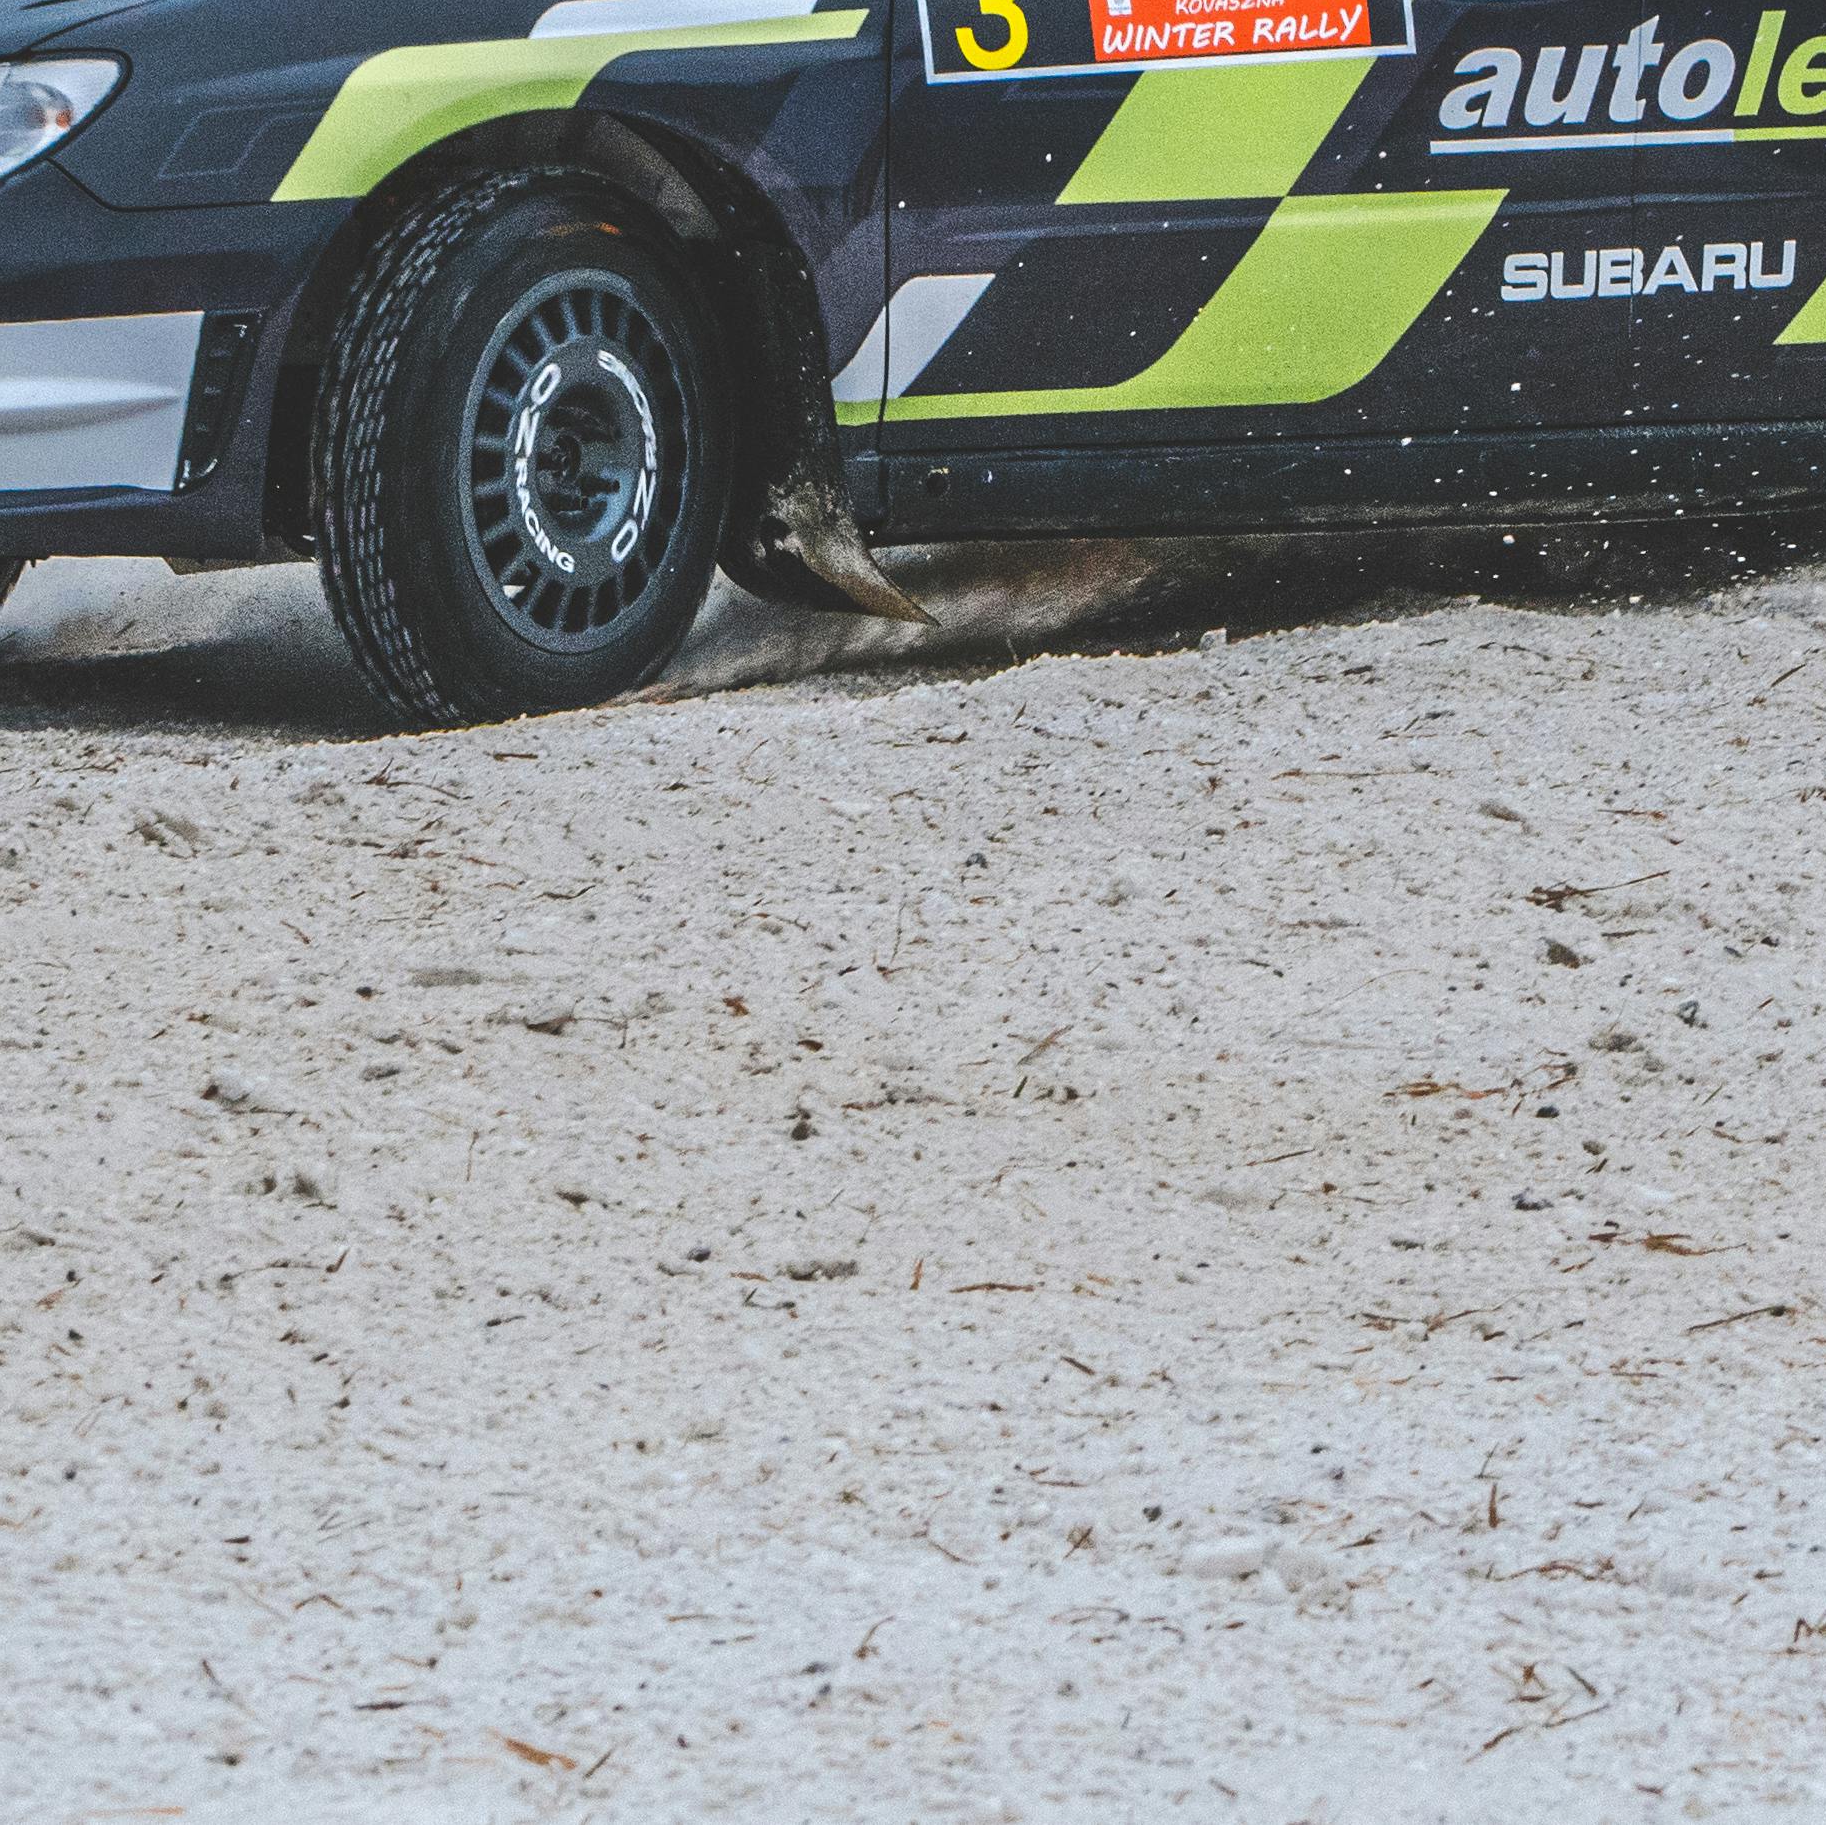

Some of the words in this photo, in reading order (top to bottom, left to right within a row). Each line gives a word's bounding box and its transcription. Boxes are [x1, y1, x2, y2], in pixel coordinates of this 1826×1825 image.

[1102, 20, 1236, 55] WINTER
[1252, 3, 1363, 45] RALLY
[1501, 240, 1796, 302] SUBARU
[515, 457, 576, 573] RACING
